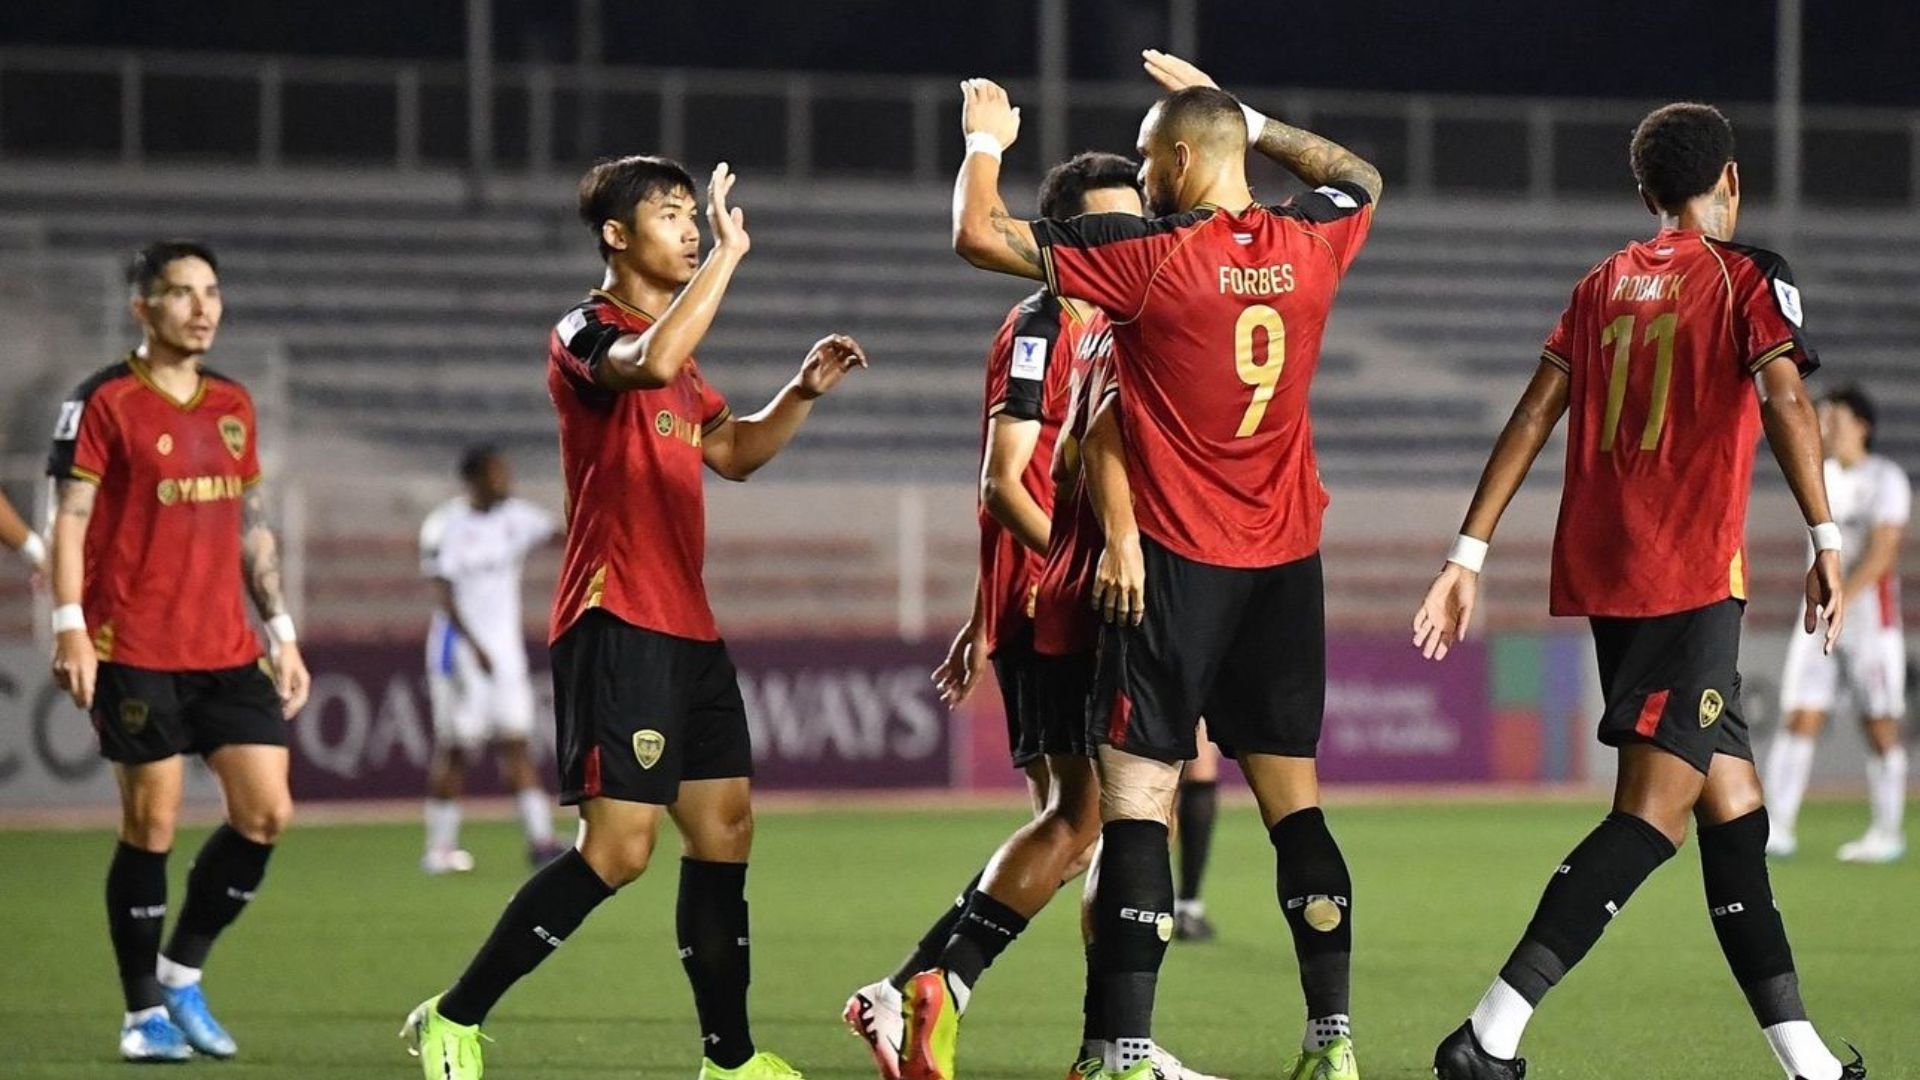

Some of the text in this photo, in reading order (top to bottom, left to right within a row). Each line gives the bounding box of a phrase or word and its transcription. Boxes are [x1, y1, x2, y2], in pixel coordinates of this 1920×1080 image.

[1219, 264, 1296, 295] FORBES
[1611, 274, 1687, 302] ROBACK
[1235, 304, 1286, 438] 9
[1601, 313, 1679, 451] 11
[737, 666, 942, 761] WAYS
[1712, 901, 1745, 917] GO
